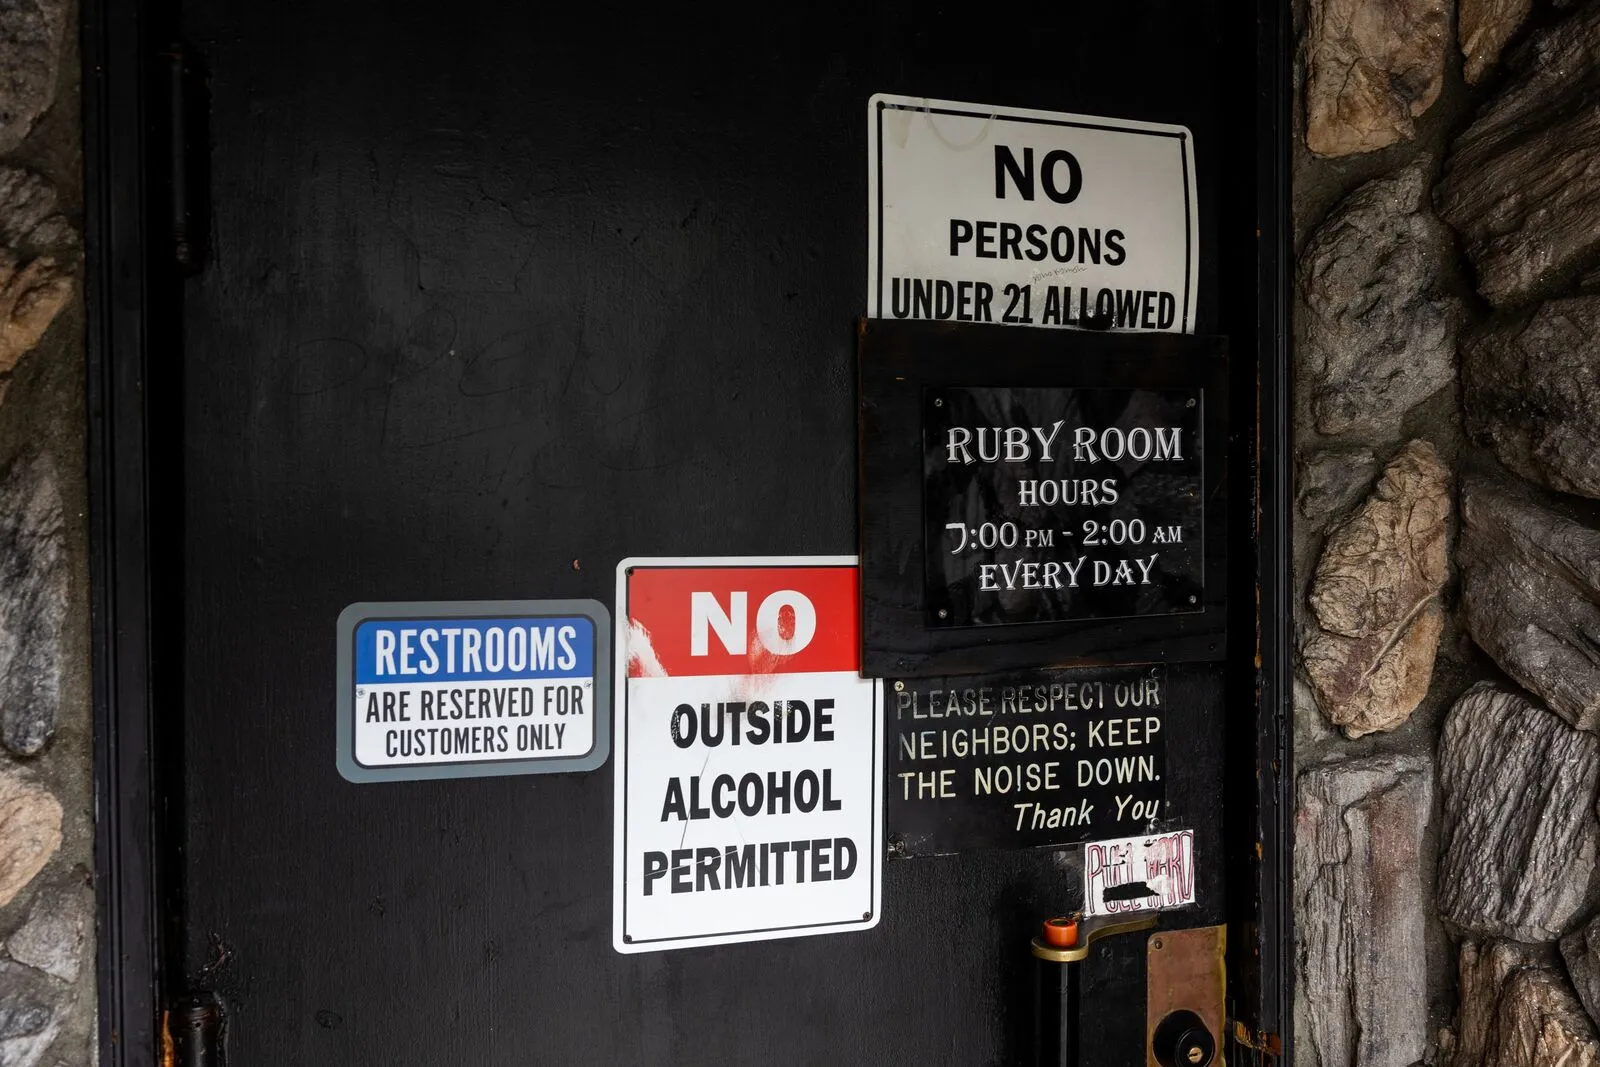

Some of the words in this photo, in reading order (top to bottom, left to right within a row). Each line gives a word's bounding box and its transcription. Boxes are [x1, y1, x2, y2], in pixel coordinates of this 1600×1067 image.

[994, 145, 1082, 204] NO
[949, 219, 1126, 266] PERSONS
[892, 277, 993, 322] UNDER
[1002, 283, 1033, 324] 21
[1042, 286, 1176, 330] ALLOWED
[946, 419, 1065, 465] RUBY
[1073, 427, 1184, 464] ROOM
[1018, 479, 1119, 507] HOURS
[945, 522, 1018, 555] 7:00
[1024, 529, 1055, 548] PM
[1082, 519, 1146, 546] 2:00
[1152, 526, 1184, 544] AM
[979, 555, 1088, 592] EVERY
[1093, 553, 1160, 587] DAY
[690, 590, 817, 656] NO
[375, 625, 577, 676] RESTROOMS
[366, 691, 411, 723] ARE
[420, 687, 533, 721] RESERVED
[543, 685, 584, 716] FOR
[896, 687, 994, 720] PLEASE
[1001, 681, 1104, 715] RESPECT
[1114, 678, 1161, 708] OUR
[385, 725, 509, 758] CUSTOMERS
[516, 723, 566, 752] ONLY
[670, 698, 835, 749] OUTSIDE
[899, 722, 1076, 761] NEIGHBORS;
[1088, 717, 1161, 748] KEEP
[660, 768, 842, 822] ALCOHOL
[897, 769, 957, 801] THE
[974, 761, 1061, 796] NOISE
[1077, 755, 1161, 787] DOWN.
[1013, 798, 1094, 831] Thank
[1114, 794, 1160, 822] You
[642, 837, 858, 897] PERMITTED
